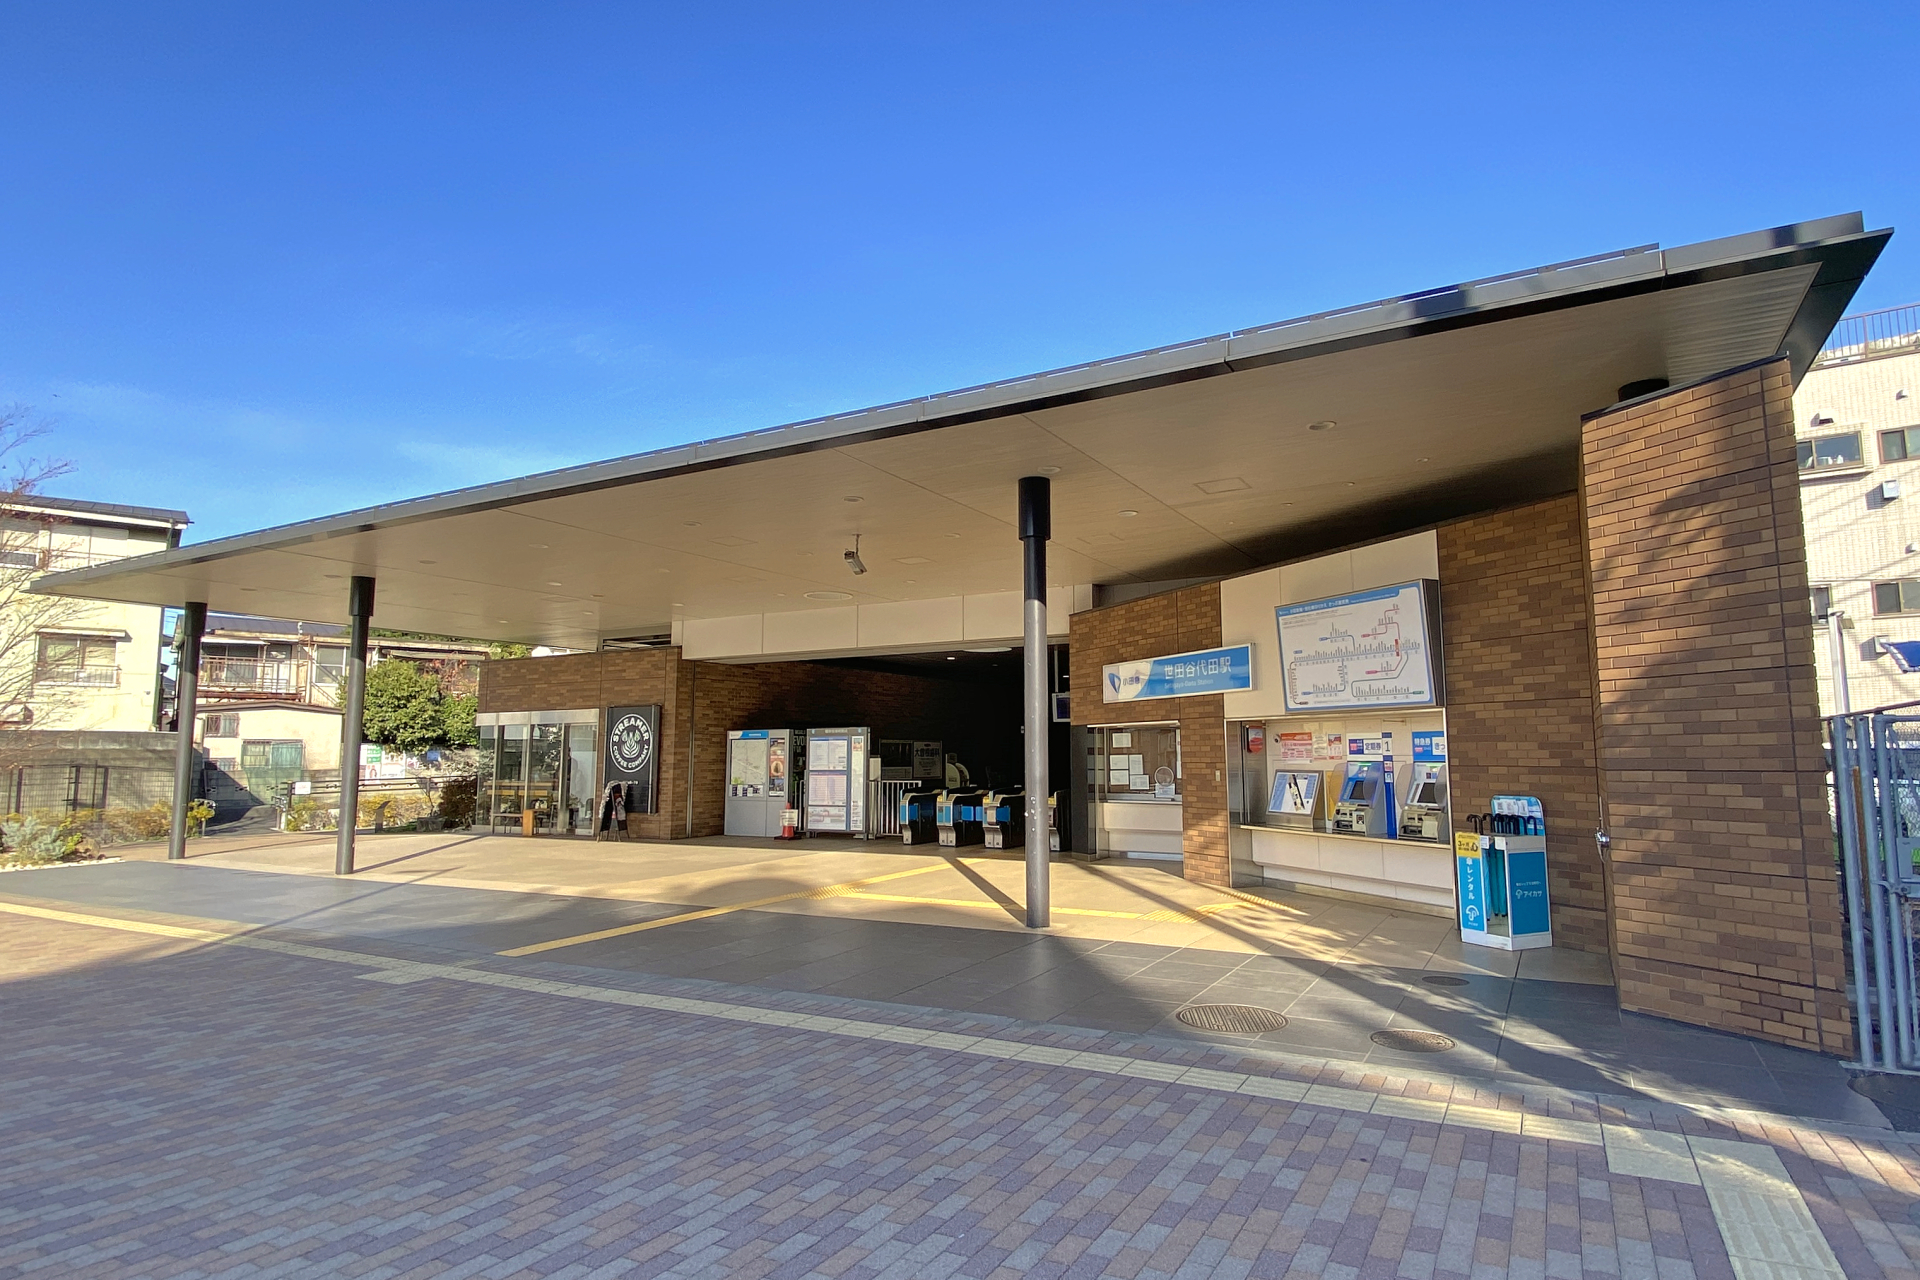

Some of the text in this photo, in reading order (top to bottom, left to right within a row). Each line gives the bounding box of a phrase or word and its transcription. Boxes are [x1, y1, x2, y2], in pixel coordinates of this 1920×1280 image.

[1164, 656, 1232, 680] 世田谷代田駅
[1122, 676, 1141, 686] 小田急
[1198, 678, 1214, 686] Station
[613, 717, 649, 743] STREAMER
[1384, 740, 1391, 752] 1
[613, 744, 649, 768] COFFEE COMPANY
[1523, 890, 1543, 898] アイカサ
